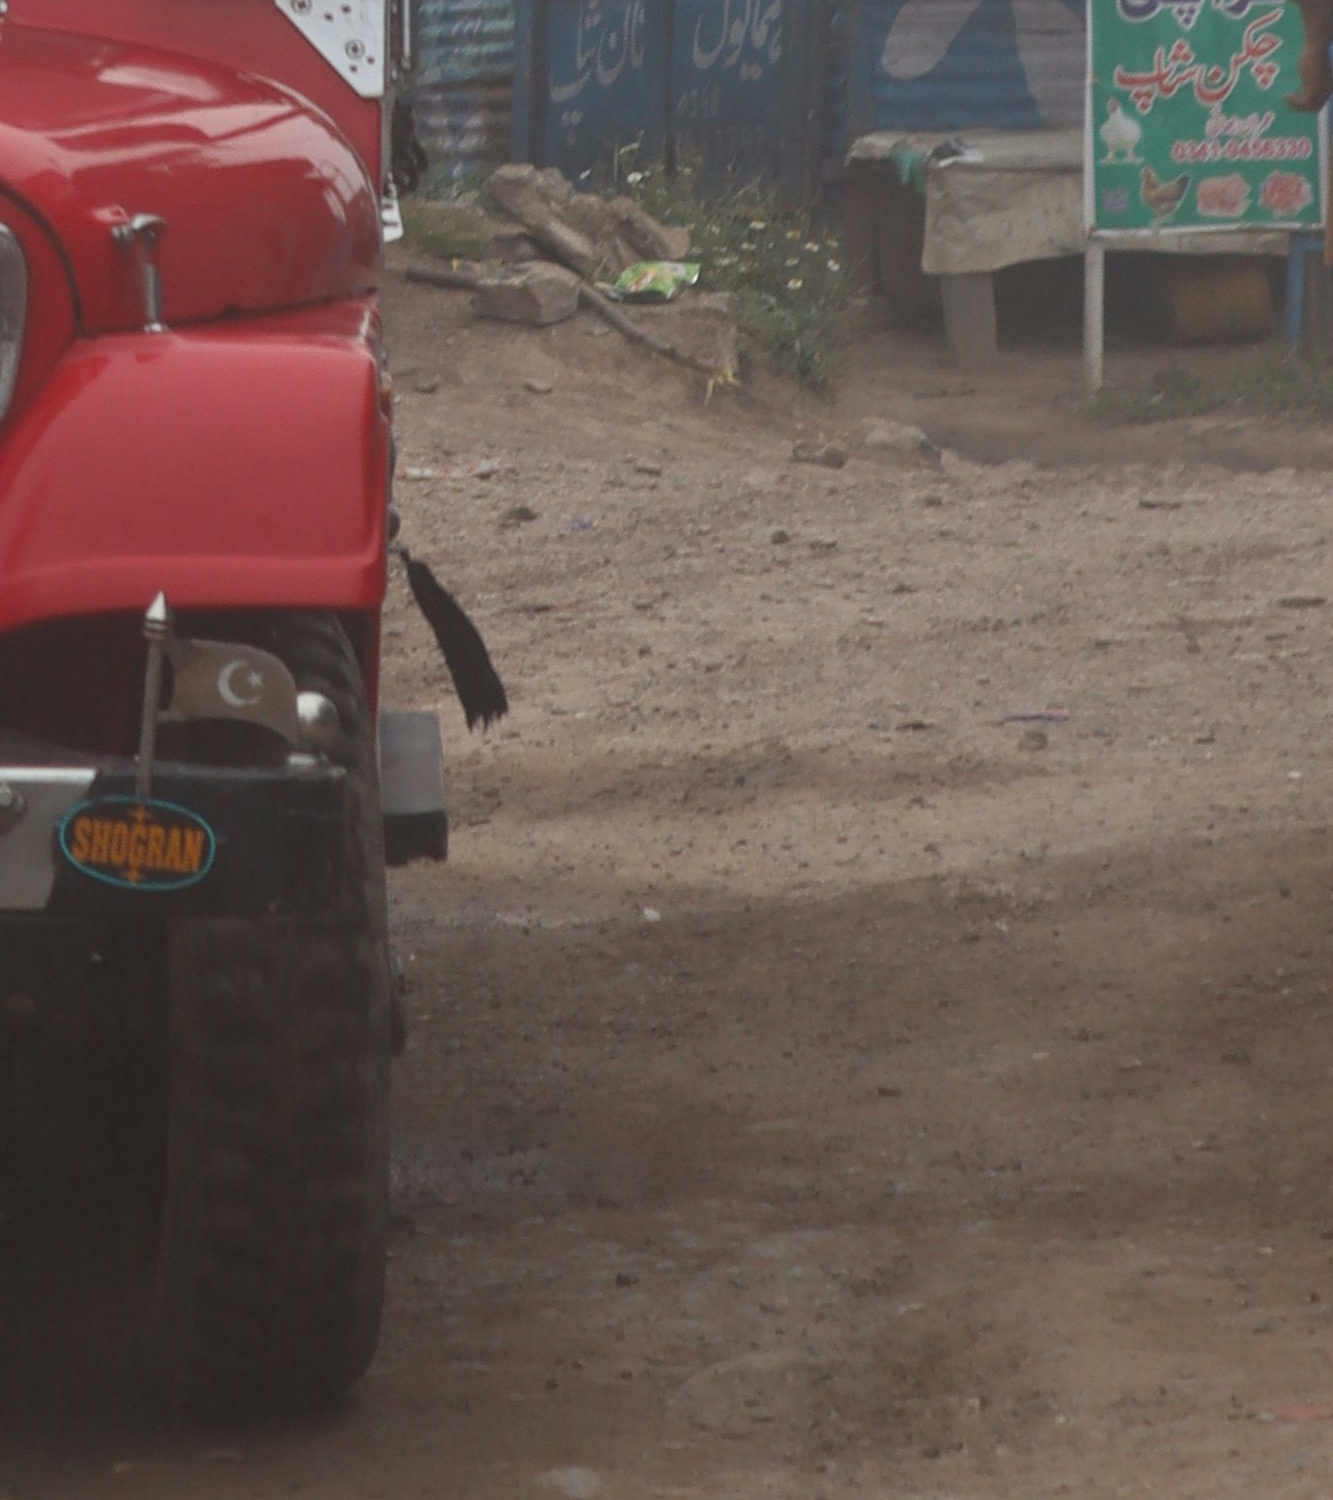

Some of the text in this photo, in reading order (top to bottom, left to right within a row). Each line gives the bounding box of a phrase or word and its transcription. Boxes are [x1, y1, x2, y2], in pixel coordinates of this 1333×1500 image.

[1115, 10, 1285, 111] چکن شاپ
[72, 815, 207, 874] SHOGRAN
